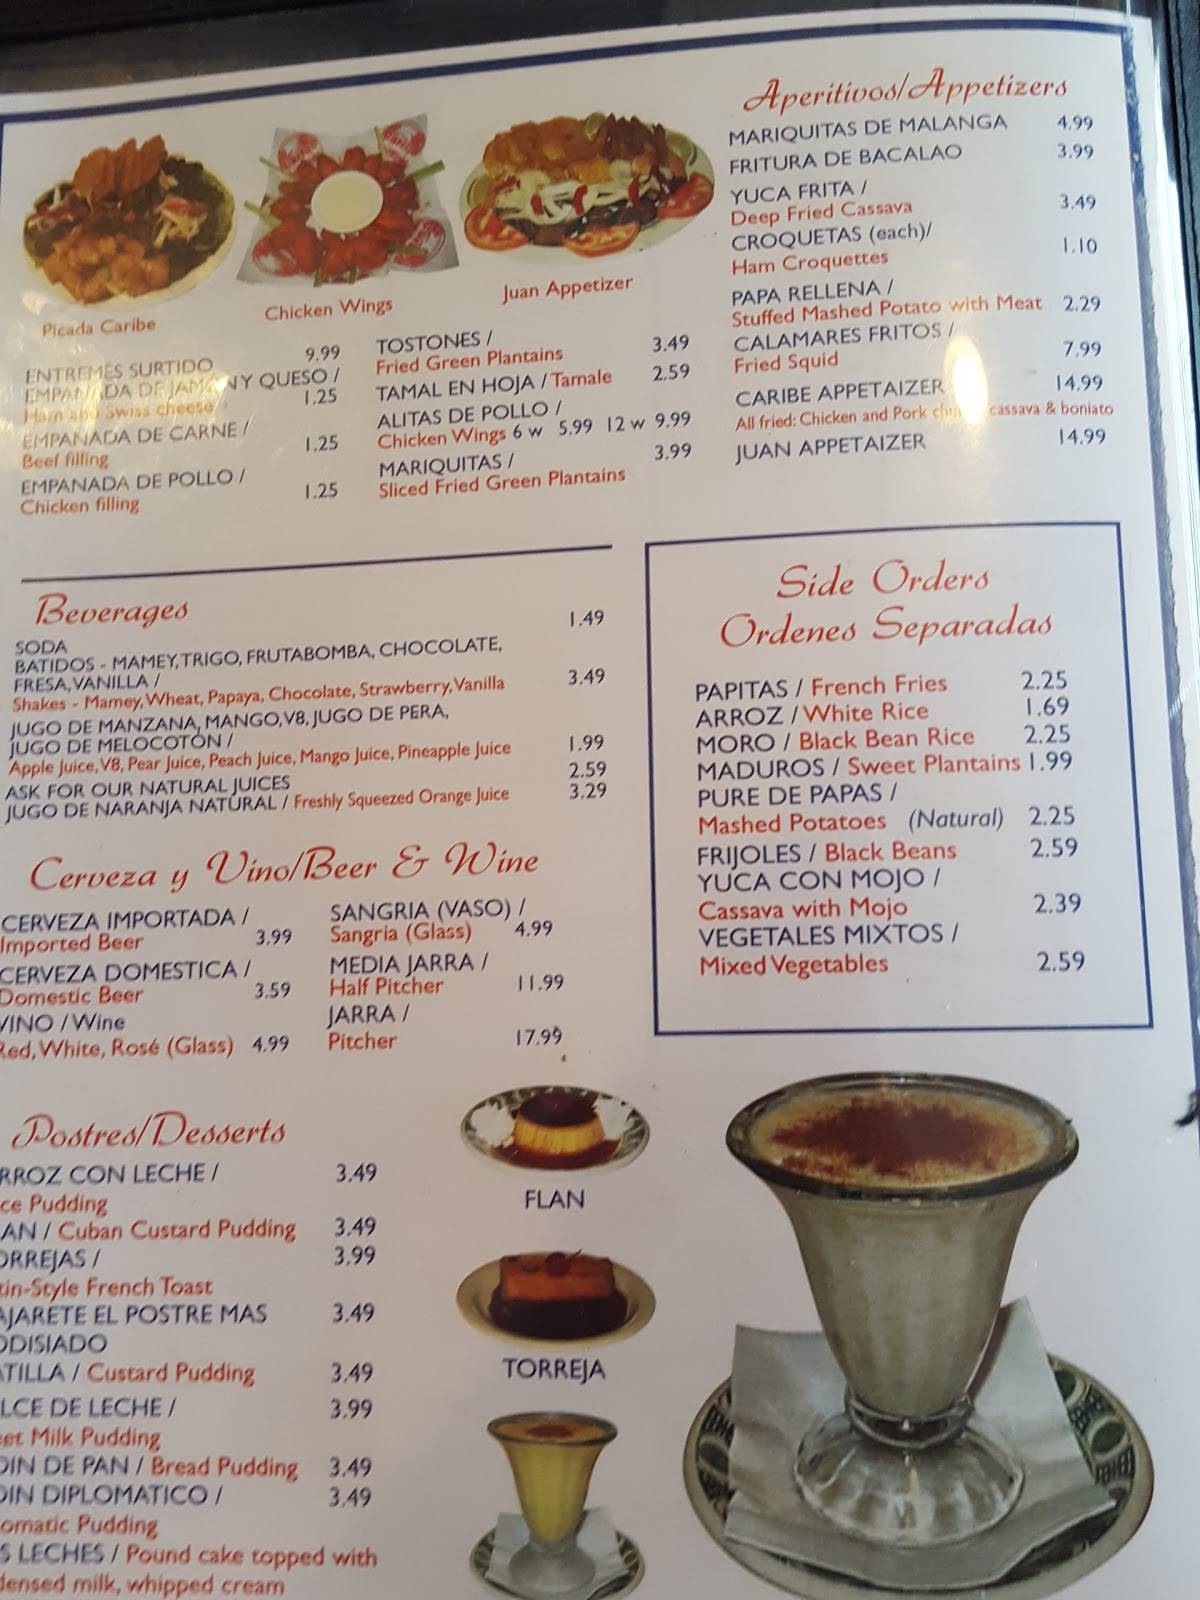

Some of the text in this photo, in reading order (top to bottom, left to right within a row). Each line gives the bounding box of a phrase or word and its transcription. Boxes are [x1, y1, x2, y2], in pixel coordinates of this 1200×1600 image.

[729, 114, 1093, 146] MARIQUITAS DE MALANGA 4.99
[730, 143, 1094, 174] FRITURA DE BACALAO 3.99
[732, 195, 1096, 227] Deep Fried Cassava 3.49
[732, 226, 862, 251] CROQUETAS
[732, 238, 1097, 275] Ham Croquettes 1.10
[503, 278, 633, 304] Juan Appetizer
[732, 280, 881, 306] PAPA RELLENA
[265, 299, 392, 321] Chicken Wings
[732, 295, 1101, 328] Stuffed Mashed Potato with Meat 2.29
[42, 318, 156, 337] Picada Caribe
[376, 335, 688, 375] Fried Green Plantains 3.49
[734, 341, 1101, 373] Fried Squid 7.99
[376, 364, 690, 401] TAMAL EN HOJA Tamale 2.59
[735, 375, 1102, 407] CARIBE APPETAIZER 14.99
[378, 411, 690, 449] Chicken Wings 6 w 5.99 12 w 9.99
[379, 443, 691, 477] MARIQUITAS 3.99
[21, 469, 233, 496] EMPANADA DE POLLO
[379, 468, 626, 498] Sliced Fried Green Plantains
[20, 482, 339, 516] Chicken filling 1.25
[776, 558, 989, 600] Side Orders
[34, 592, 190, 629] Beverages
[720, 602, 1053, 648] Ordenes Separadas
[16, 610, 604, 655] SODA 1.49
[696, 670, 1068, 702] PAPITAS French Fries 2.25
[696, 697, 1069, 728] ARROZ White Rice 1.69
[696, 723, 1071, 755] MORO Black Bean Rice 2.25
[5, 761, 607, 801] ASK FOR OUR NATURAL JUICES 2.59
[697, 751, 1073, 781] MADUROS Sweet Plantains 1.99
[5, 783, 607, 824] JUGO DE NARANJA NATURAL Freshly Squeezed Orange Juice 3.29
[699, 806, 1075, 835] Mashed Potatoes (Natural) 2.25
[30, 856, 157, 890] Cerveza
[170, 869, 189, 893] y
[391, 844, 430, 879] &
[445, 841, 539, 876] Wine
[697, 837, 1078, 870] FRIJOLES Black Beans 2.59
[2, 908, 236, 933] CERVEZA IMPORTADA
[330, 898, 511, 923] SANGRIA (VASO)
[698, 893, 1081, 921] Cassava with Mojo 2.39
[330, 920, 553, 948] Sangria (Glass) 4.99
[698, 923, 944, 948] VEGETALES MIXTOS
[700, 951, 1085, 979] Mixed Vegetables 2.59
[329, 974, 565, 997] Half Pitcher 11.99
[329, 1028, 563, 1050] Pitcher 17.99
[524, 1189, 585, 1209] FLAN
[58, 1217, 376, 1243] Cuban Custard Pudding 3.49
[502, 1358, 606, 1385] TORREJA
[151, 1456, 372, 1481] Bread Pudding 3.49
